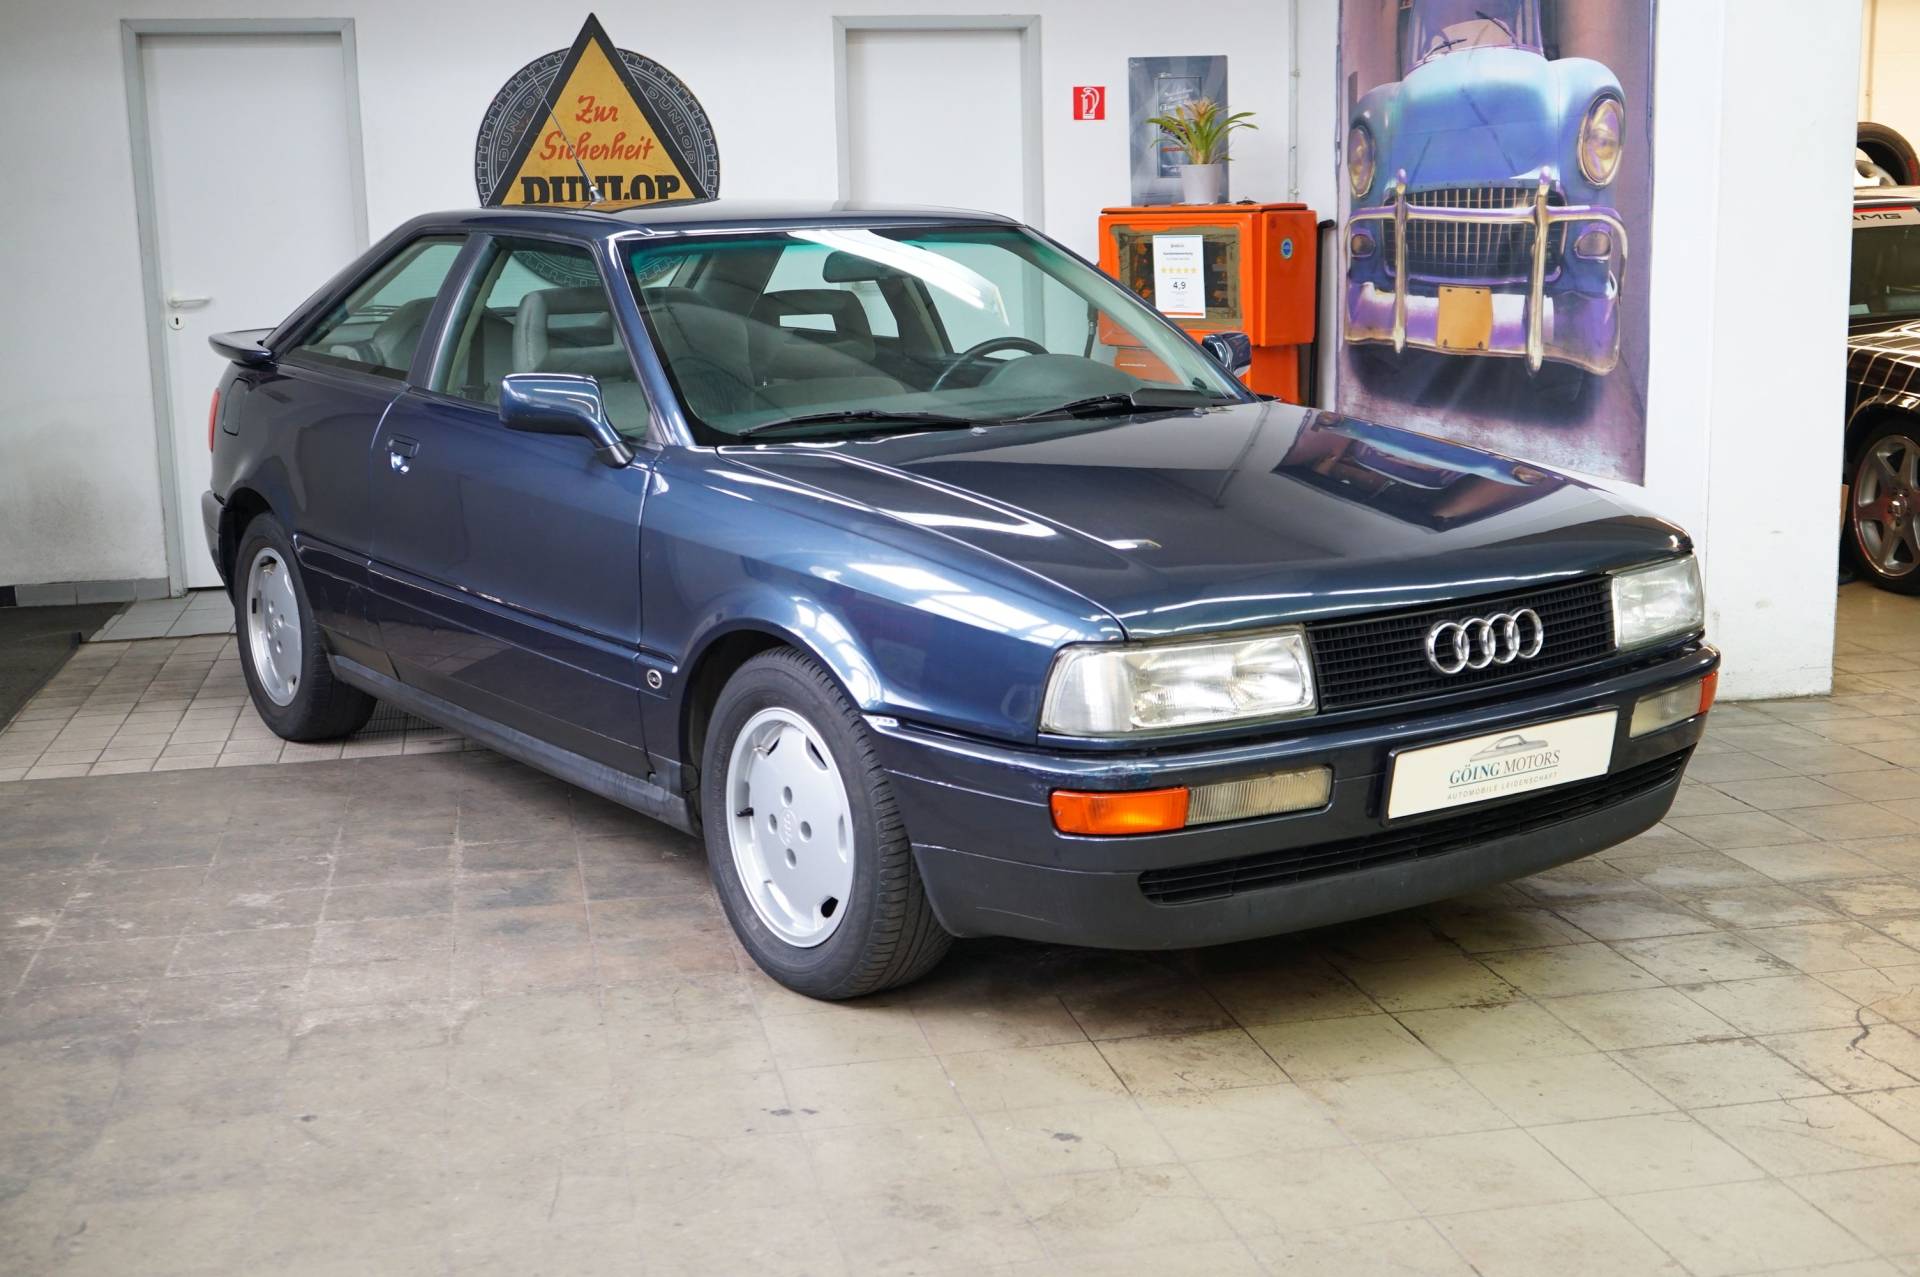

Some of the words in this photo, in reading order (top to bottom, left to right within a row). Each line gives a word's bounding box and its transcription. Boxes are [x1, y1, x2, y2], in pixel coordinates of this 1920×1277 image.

[499, 85, 546, 161] DUNLOP
[575, 95, 619, 124] Zur
[646, 86, 696, 164] DUNLOP
[540, 130, 654, 161] Sicherheit
[1172, 280, 1187, 291] 4,9
[1449, 762, 1500, 785] GÖING
[1504, 750, 1560, 774] MOTORS
[1447, 784, 1498, 800] AUTOMOBILE
[1501, 771, 1558, 790] LEIDENSCHAFT
